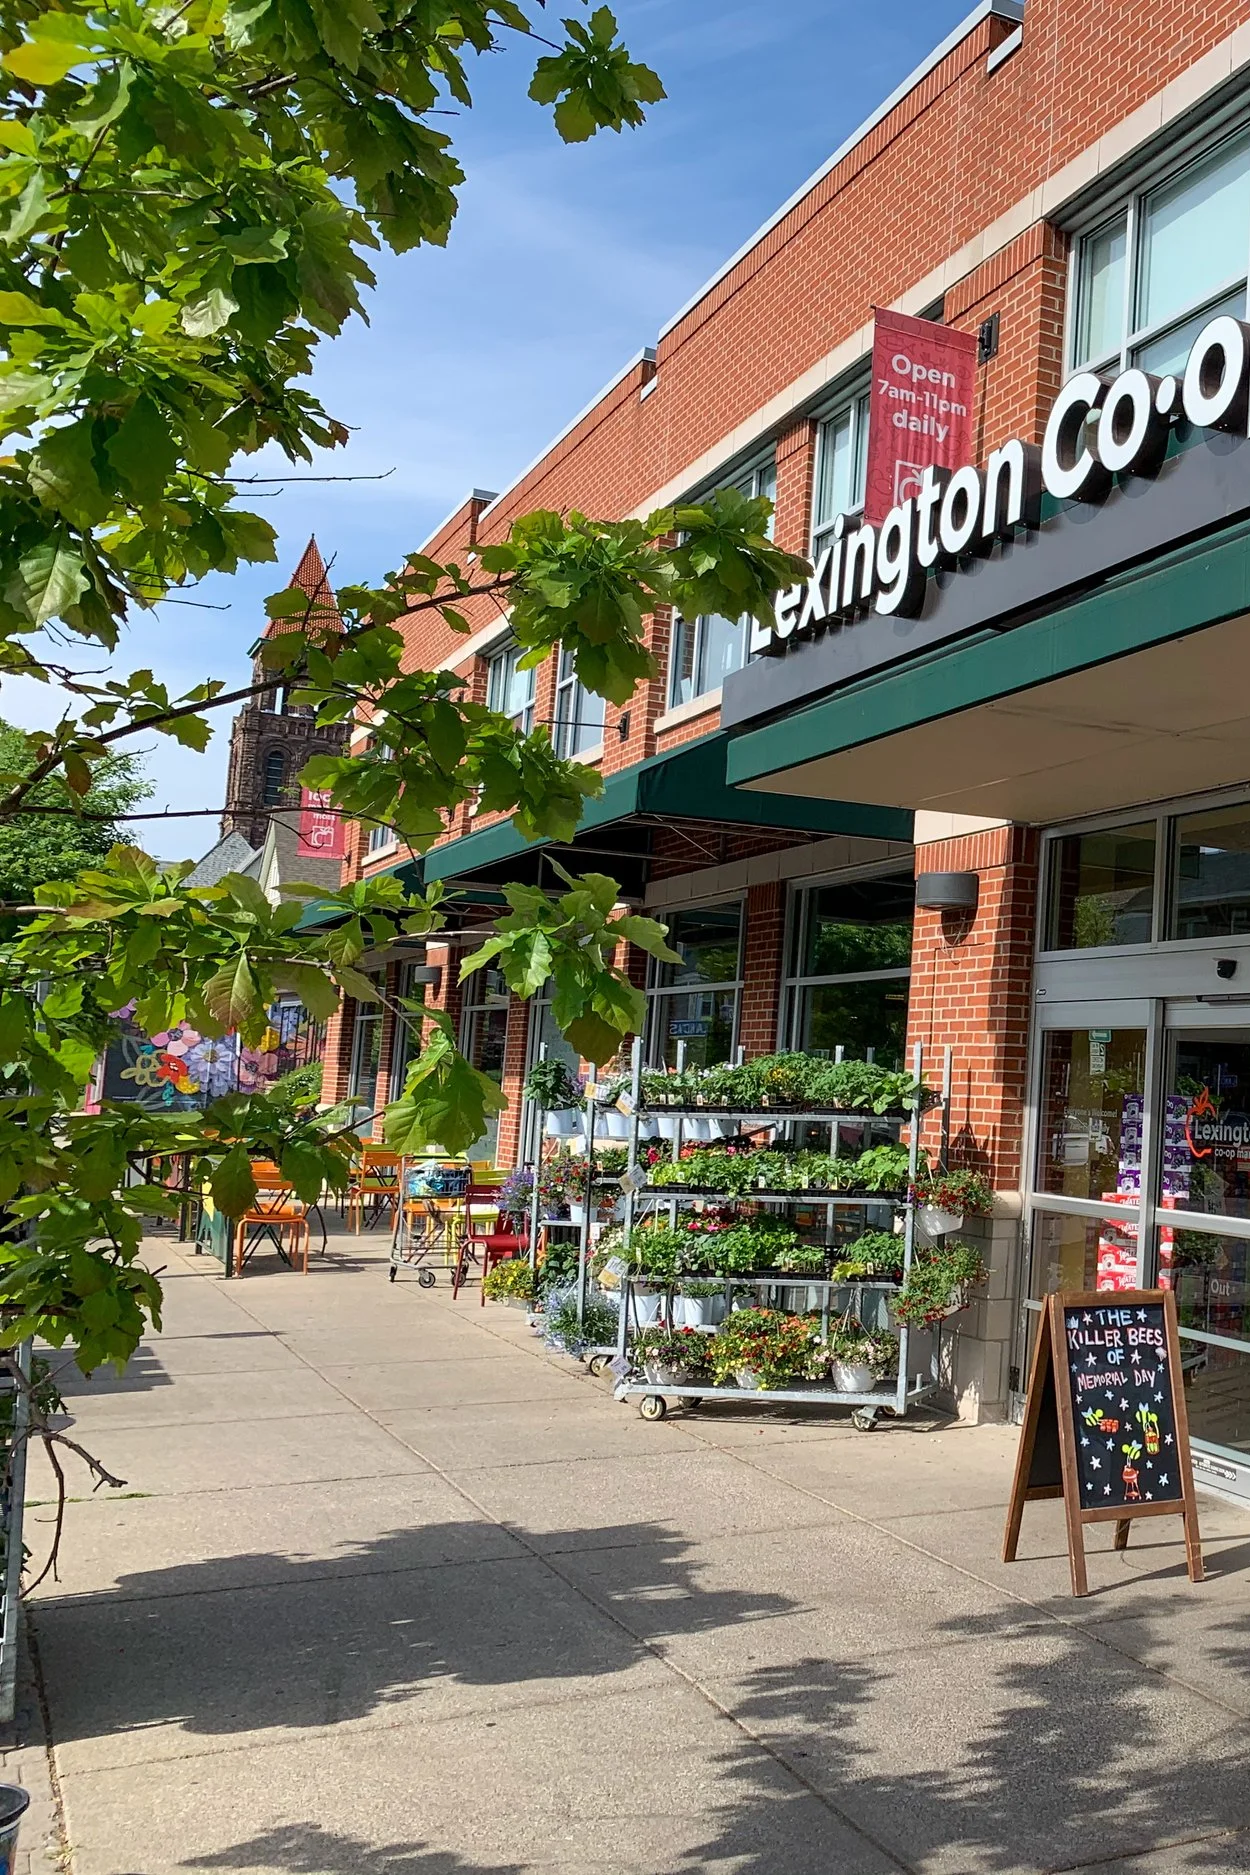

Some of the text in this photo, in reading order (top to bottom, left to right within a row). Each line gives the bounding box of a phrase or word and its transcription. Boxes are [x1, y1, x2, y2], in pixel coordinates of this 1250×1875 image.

[891, 354, 956, 388] Open
[877, 379, 967, 417] 7am-11pm
[892, 409, 950, 443] daily
[1210, 1278, 1230, 1296] Out
[1095, 1309, 1133, 1327] THE
[1067, 1327, 1163, 1350] KILLER BEES
[1106, 1348, 1125, 1366] OF
[1077, 1369, 1156, 1392] MEMORIAL DAY
